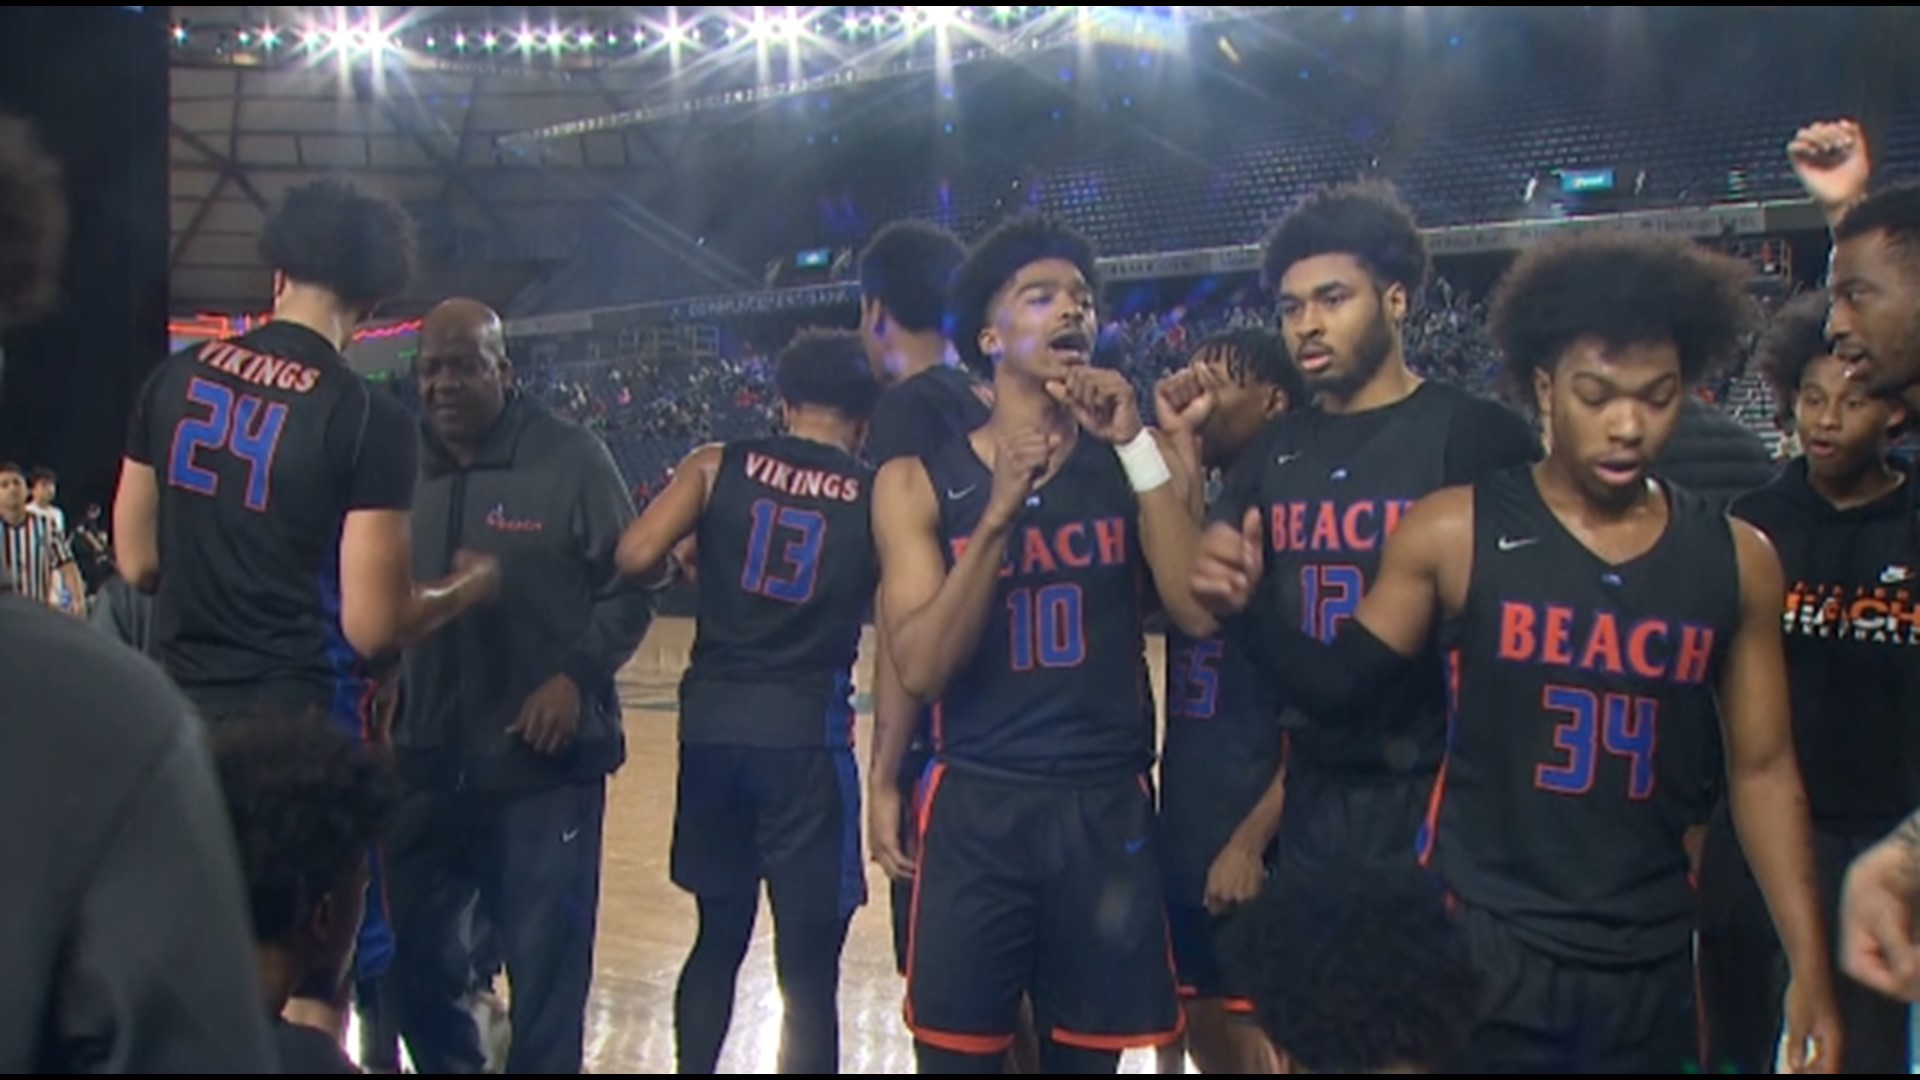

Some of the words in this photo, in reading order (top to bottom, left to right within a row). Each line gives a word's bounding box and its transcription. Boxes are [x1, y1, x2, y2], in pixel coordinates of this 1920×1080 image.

[197, 340, 321, 392] VIKINGS
[168, 377, 289, 512] 24
[745, 452, 860, 502] VIKINGS
[740, 499, 827, 603] 13
[950, 516, 1127, 577] ACH
[1006, 582, 1086, 671] 10
[1301, 564, 1364, 645] 12
[1500, 600, 1714, 684] BEACH
[1534, 685, 1657, 799] 34
